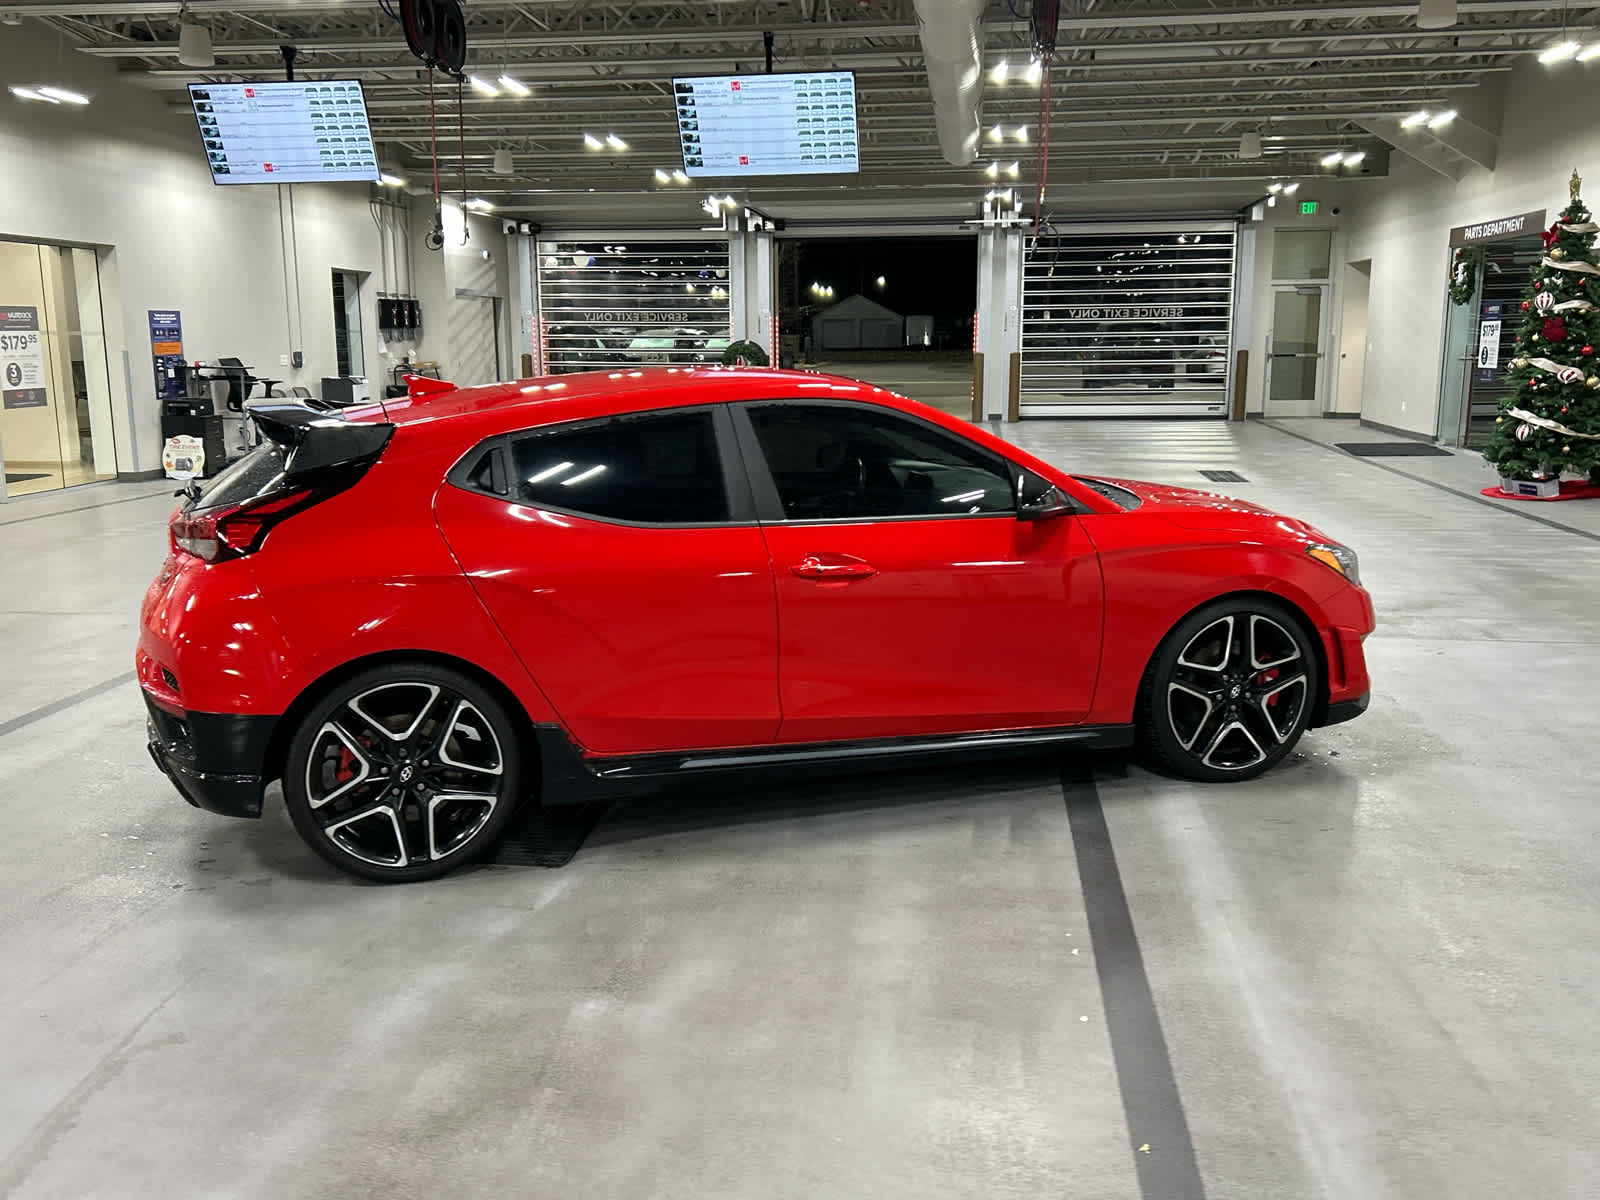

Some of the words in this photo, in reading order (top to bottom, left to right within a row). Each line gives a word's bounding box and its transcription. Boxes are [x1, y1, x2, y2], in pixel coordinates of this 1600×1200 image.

[1302, 201, 1316, 214] EXIT
[1464, 226, 1482, 240] PARTS
[1482, 217, 1525, 237] DEPARTMENT
[10, 364, 17, 377] 3
